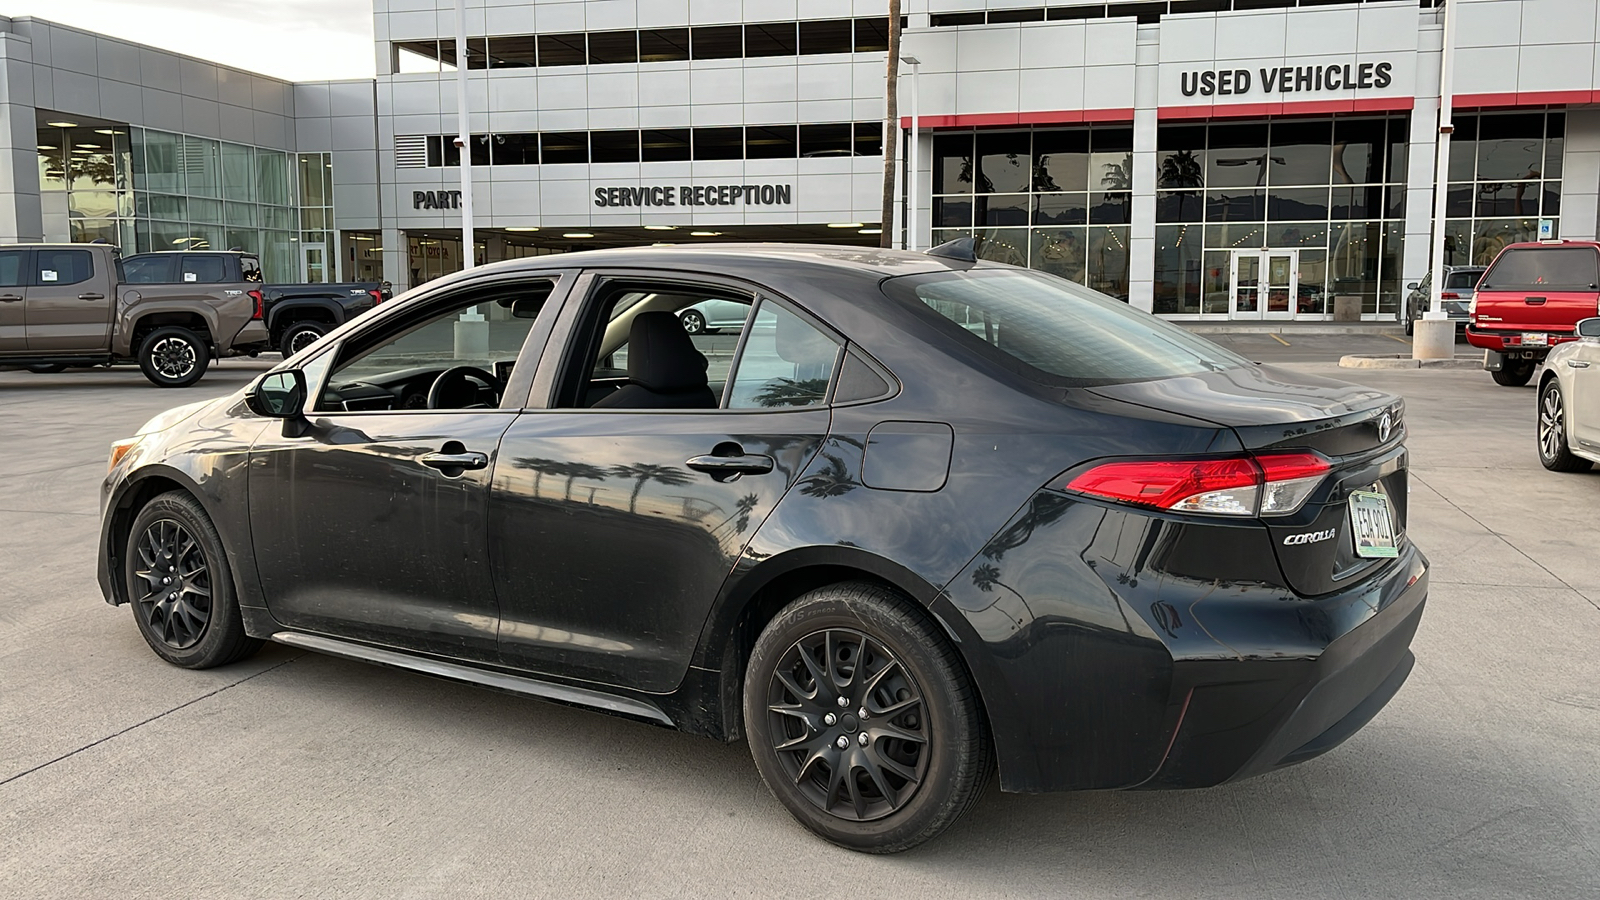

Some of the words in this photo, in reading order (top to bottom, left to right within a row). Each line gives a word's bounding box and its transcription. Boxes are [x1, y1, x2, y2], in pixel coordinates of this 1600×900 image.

[1181, 69, 1251, 96] USED
[1260, 62, 1393, 93] VEHICLES
[594, 186, 676, 207] SERVICE
[679, 184, 791, 206] RECEPTION
[1283, 527, 1336, 546] COROLLA
